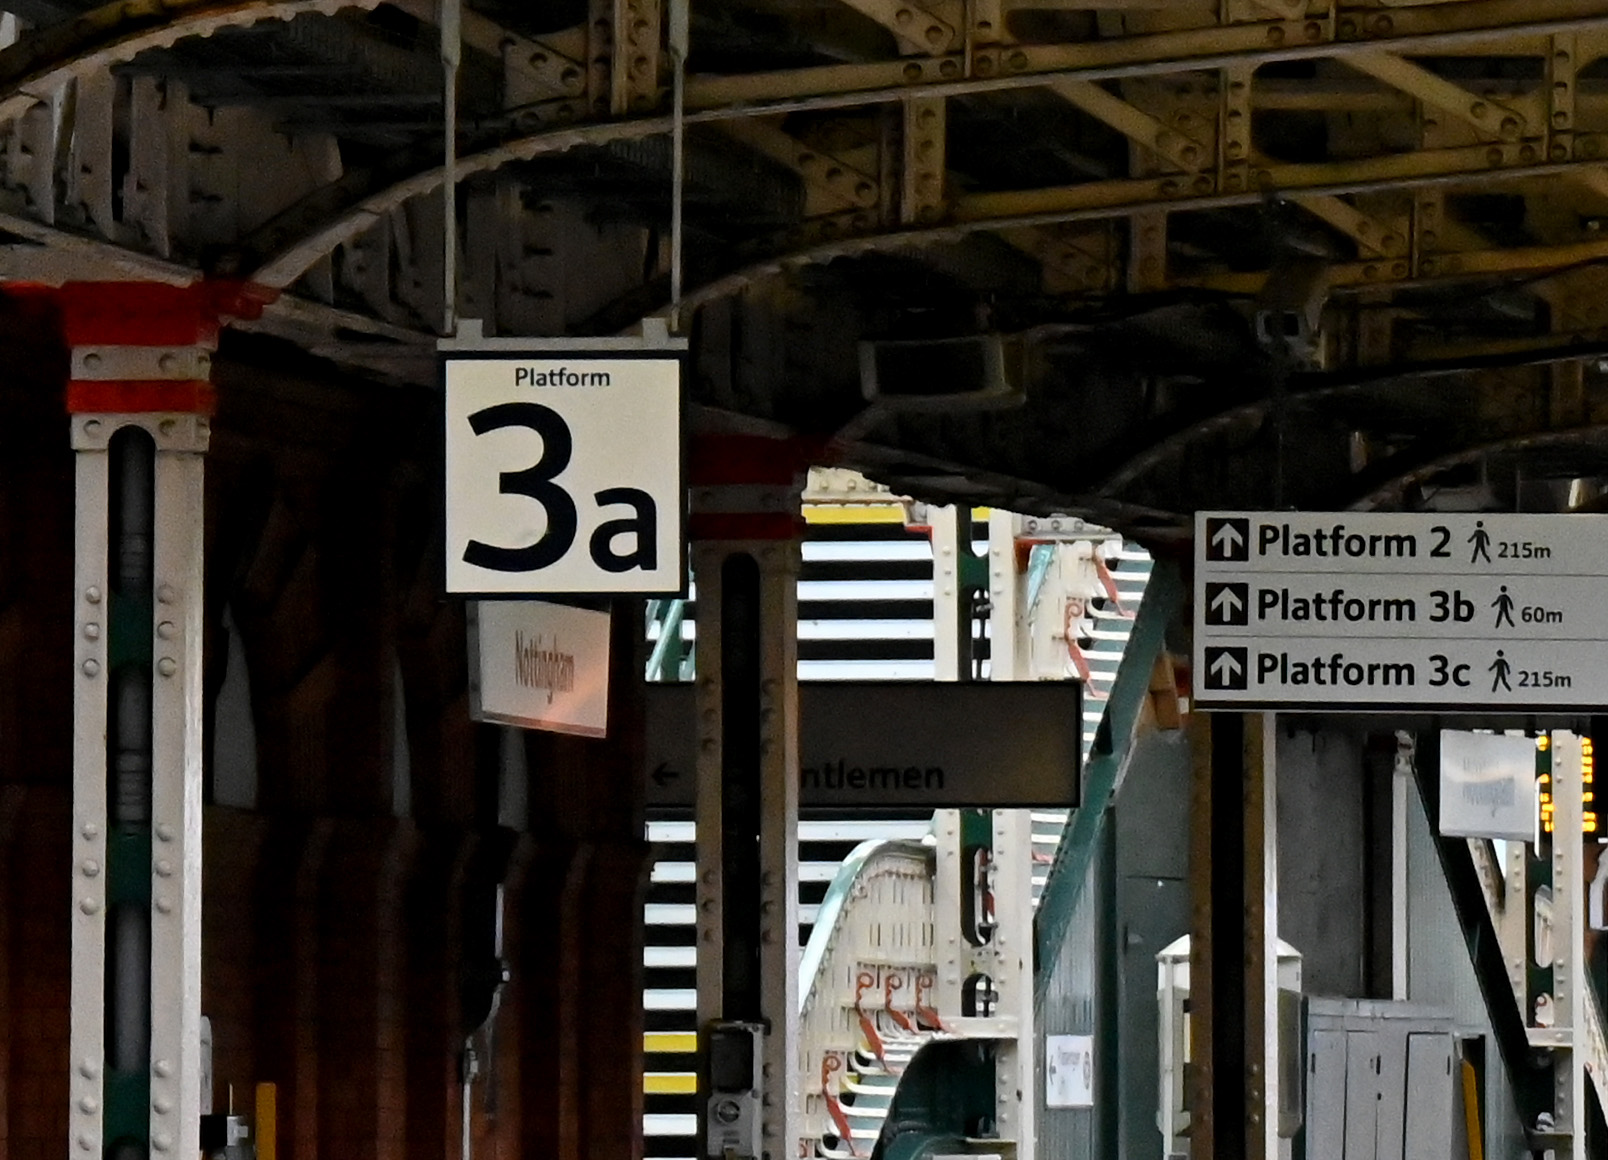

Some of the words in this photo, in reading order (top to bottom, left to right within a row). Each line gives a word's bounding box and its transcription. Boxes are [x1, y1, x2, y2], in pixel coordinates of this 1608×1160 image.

[514, 367, 611, 388] Platform
[462, 401, 658, 573] 3a
[1258, 524, 1417, 558] Platform
[1429, 526, 1452, 558] 2
[1497, 542, 1551, 559] 215m
[1257, 588, 1416, 622] Platform
[1428, 590, 1475, 622] 3b
[1521, 607, 1563, 624] 60m
[1256, 652, 1415, 687] Platform
[1428, 655, 1472, 687] 3c
[1517, 671, 1572, 688] 215m
[802, 759, 945, 789] ntlemen
